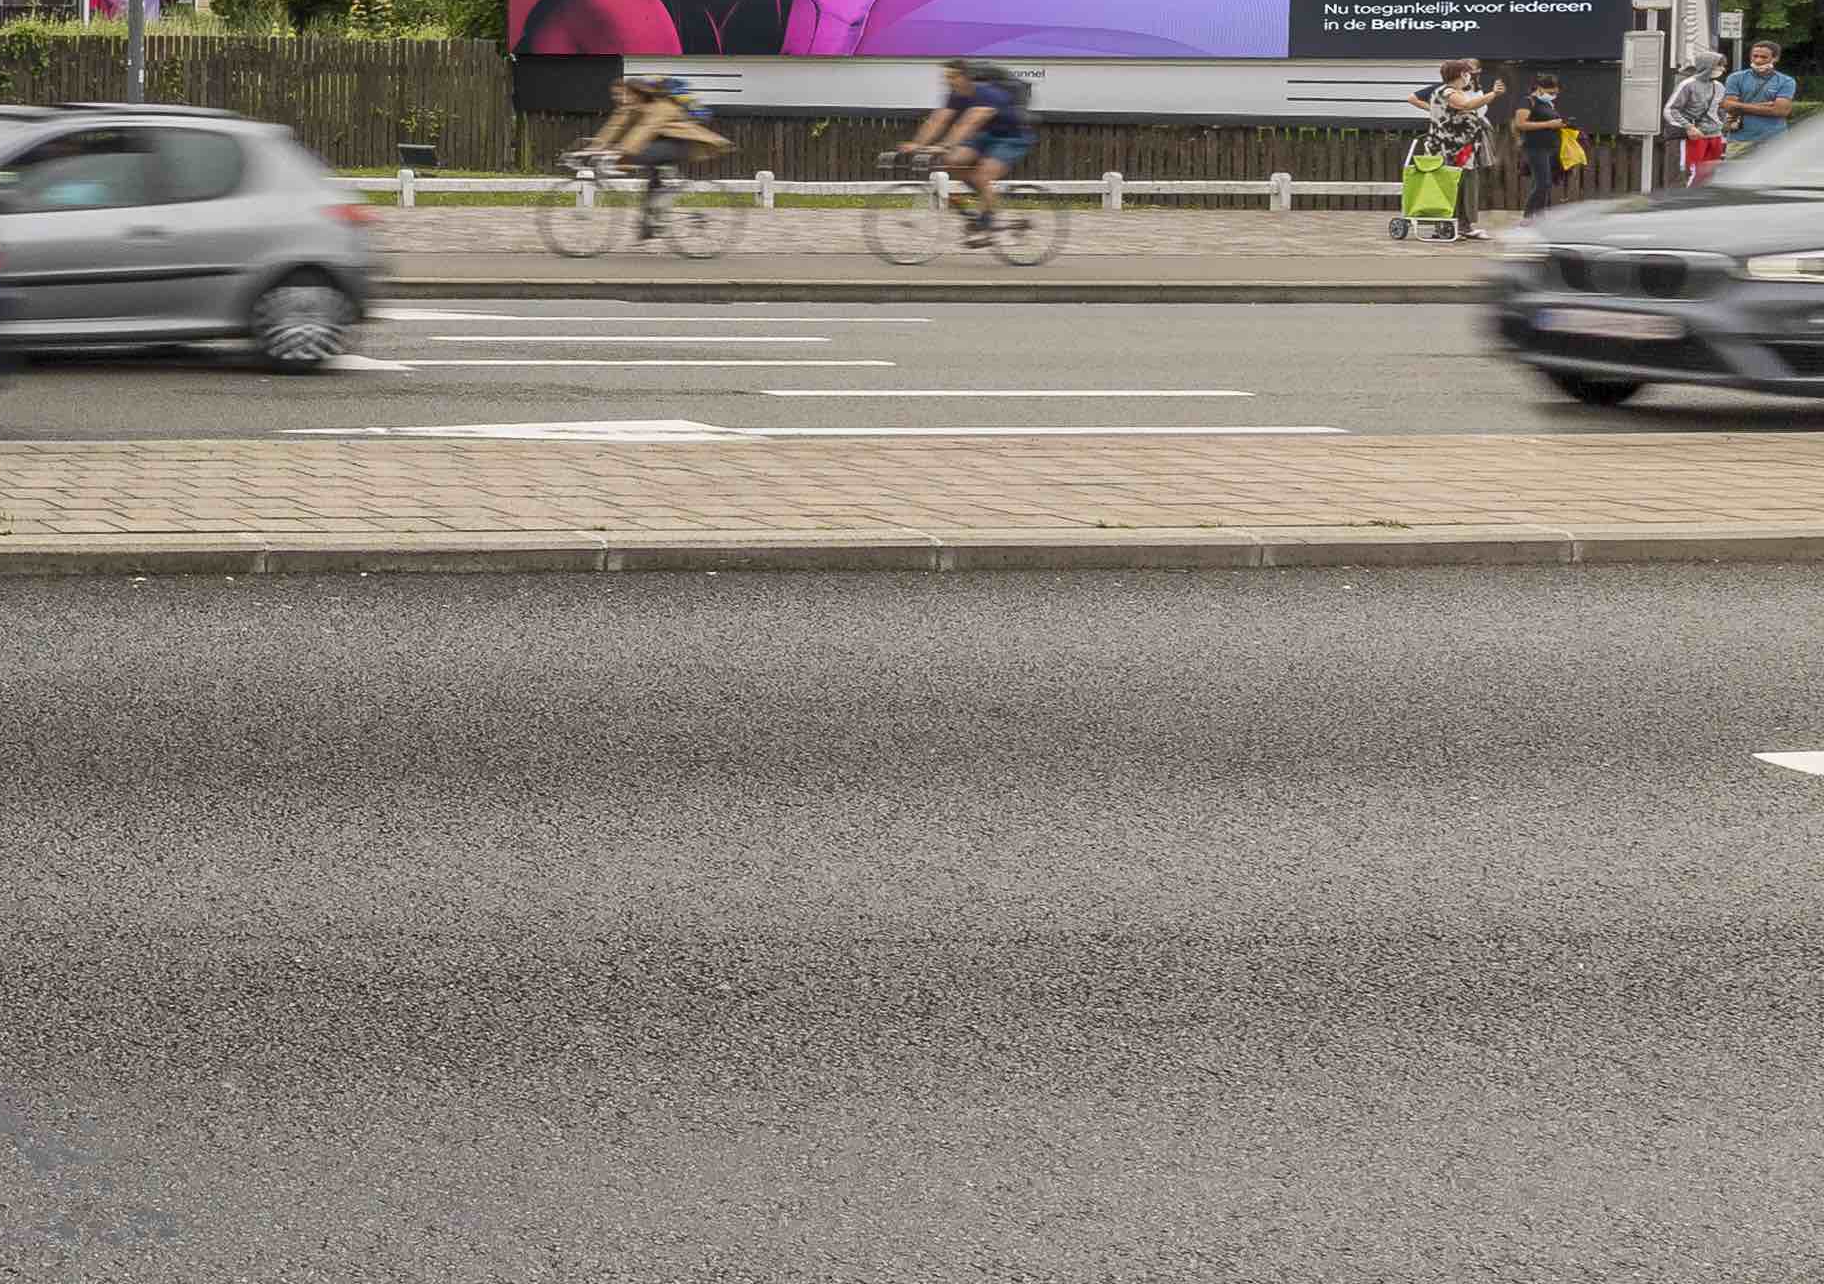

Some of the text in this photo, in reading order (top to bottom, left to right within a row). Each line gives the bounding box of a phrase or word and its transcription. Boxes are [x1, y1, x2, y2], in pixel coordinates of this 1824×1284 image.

[1324, 0, 1593, 17] Nu toegankelijk voor iedereen
[1324, 18, 1481, 32] in de Belfius-app.
